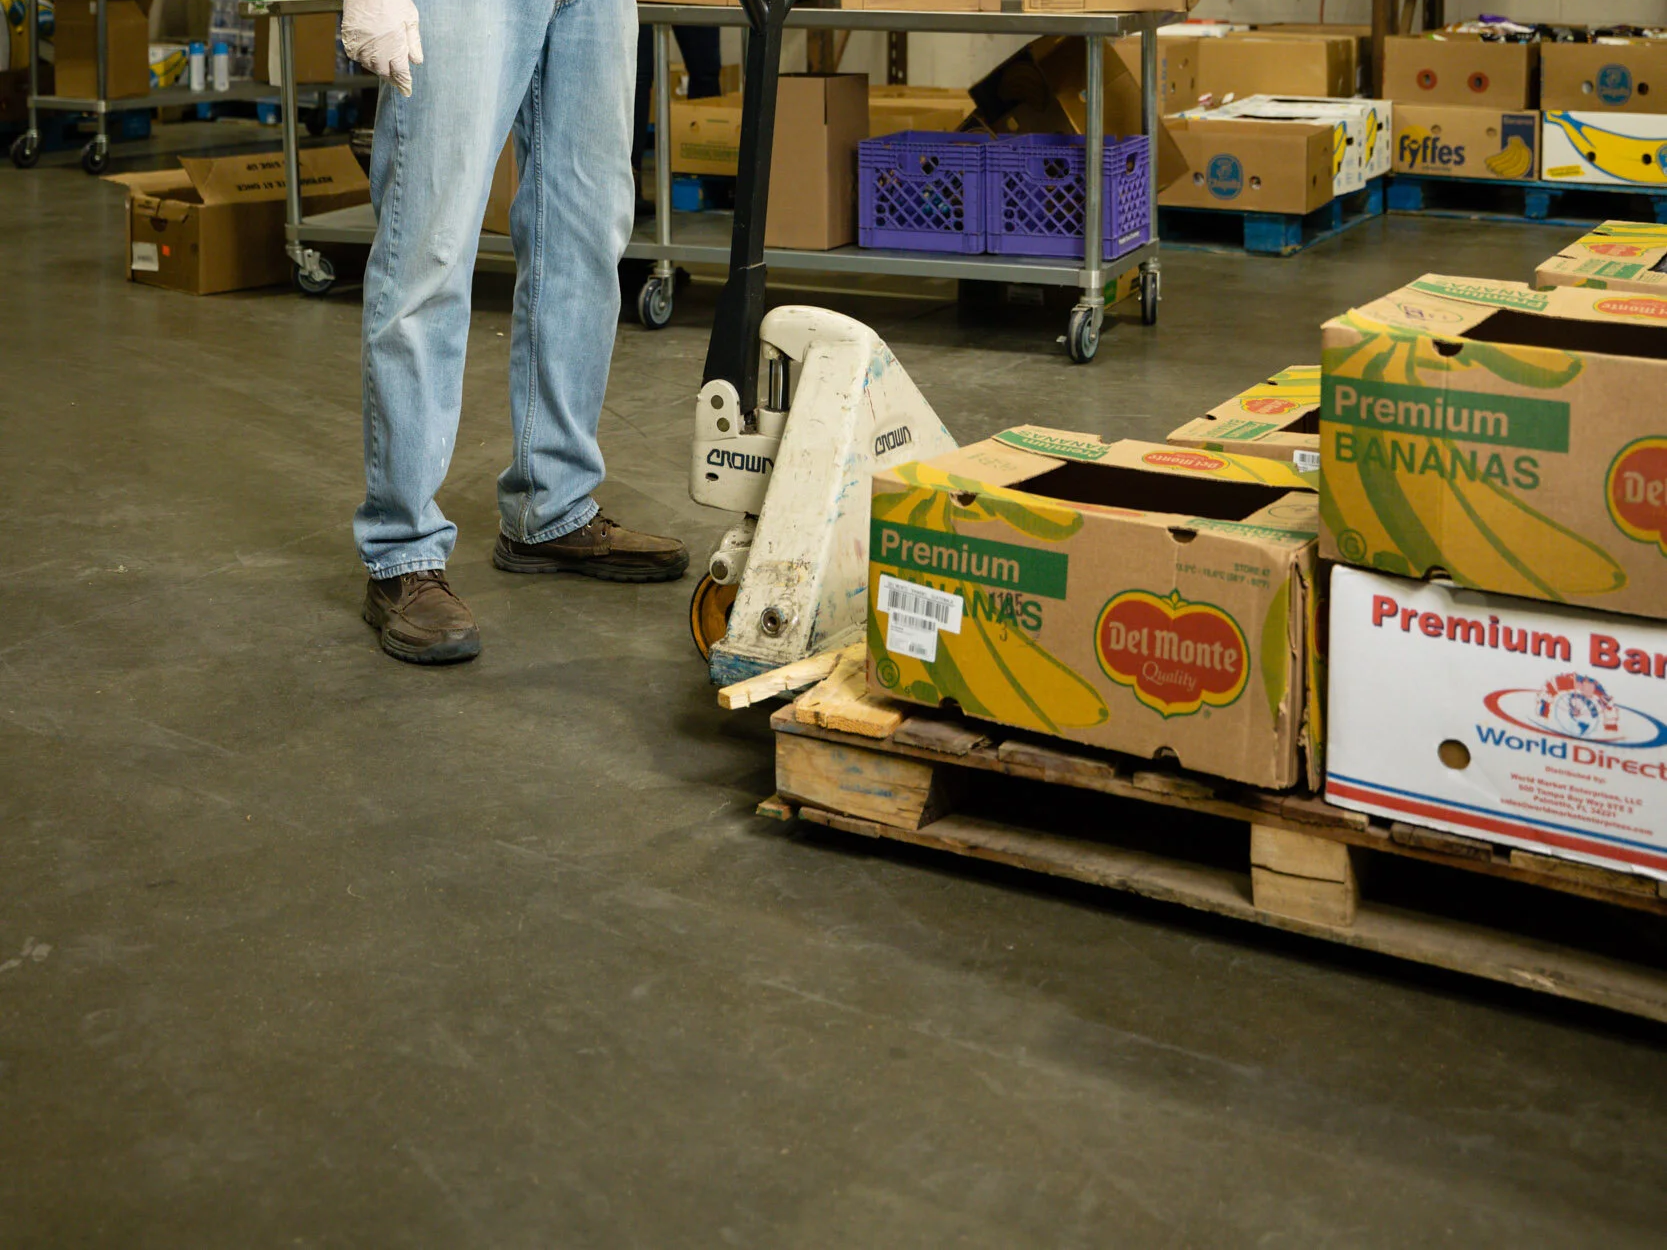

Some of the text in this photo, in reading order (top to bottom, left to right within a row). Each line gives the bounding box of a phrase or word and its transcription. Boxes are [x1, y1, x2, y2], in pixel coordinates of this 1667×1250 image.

[1399, 134, 1466, 169] fyffes
[1334, 384, 1509, 438] Premium
[1335, 430, 1540, 490] BANANAS
[1623, 471, 1667, 506] De
[881, 528, 1021, 584] Premium
[1371, 593, 1572, 662] Premium
[1108, 621, 1239, 673] Del Monte
[1142, 661, 1198, 692] Quality
[1475, 723, 1568, 760] World
[1510, 772, 1535, 784] World
[1537, 775, 1567, 791] Market
[1624, 795, 1643, 806] LLC
[1537, 787, 1565, 800] Tampa
[1567, 793, 1583, 805] Bay
[1586, 796, 1605, 809] Way
